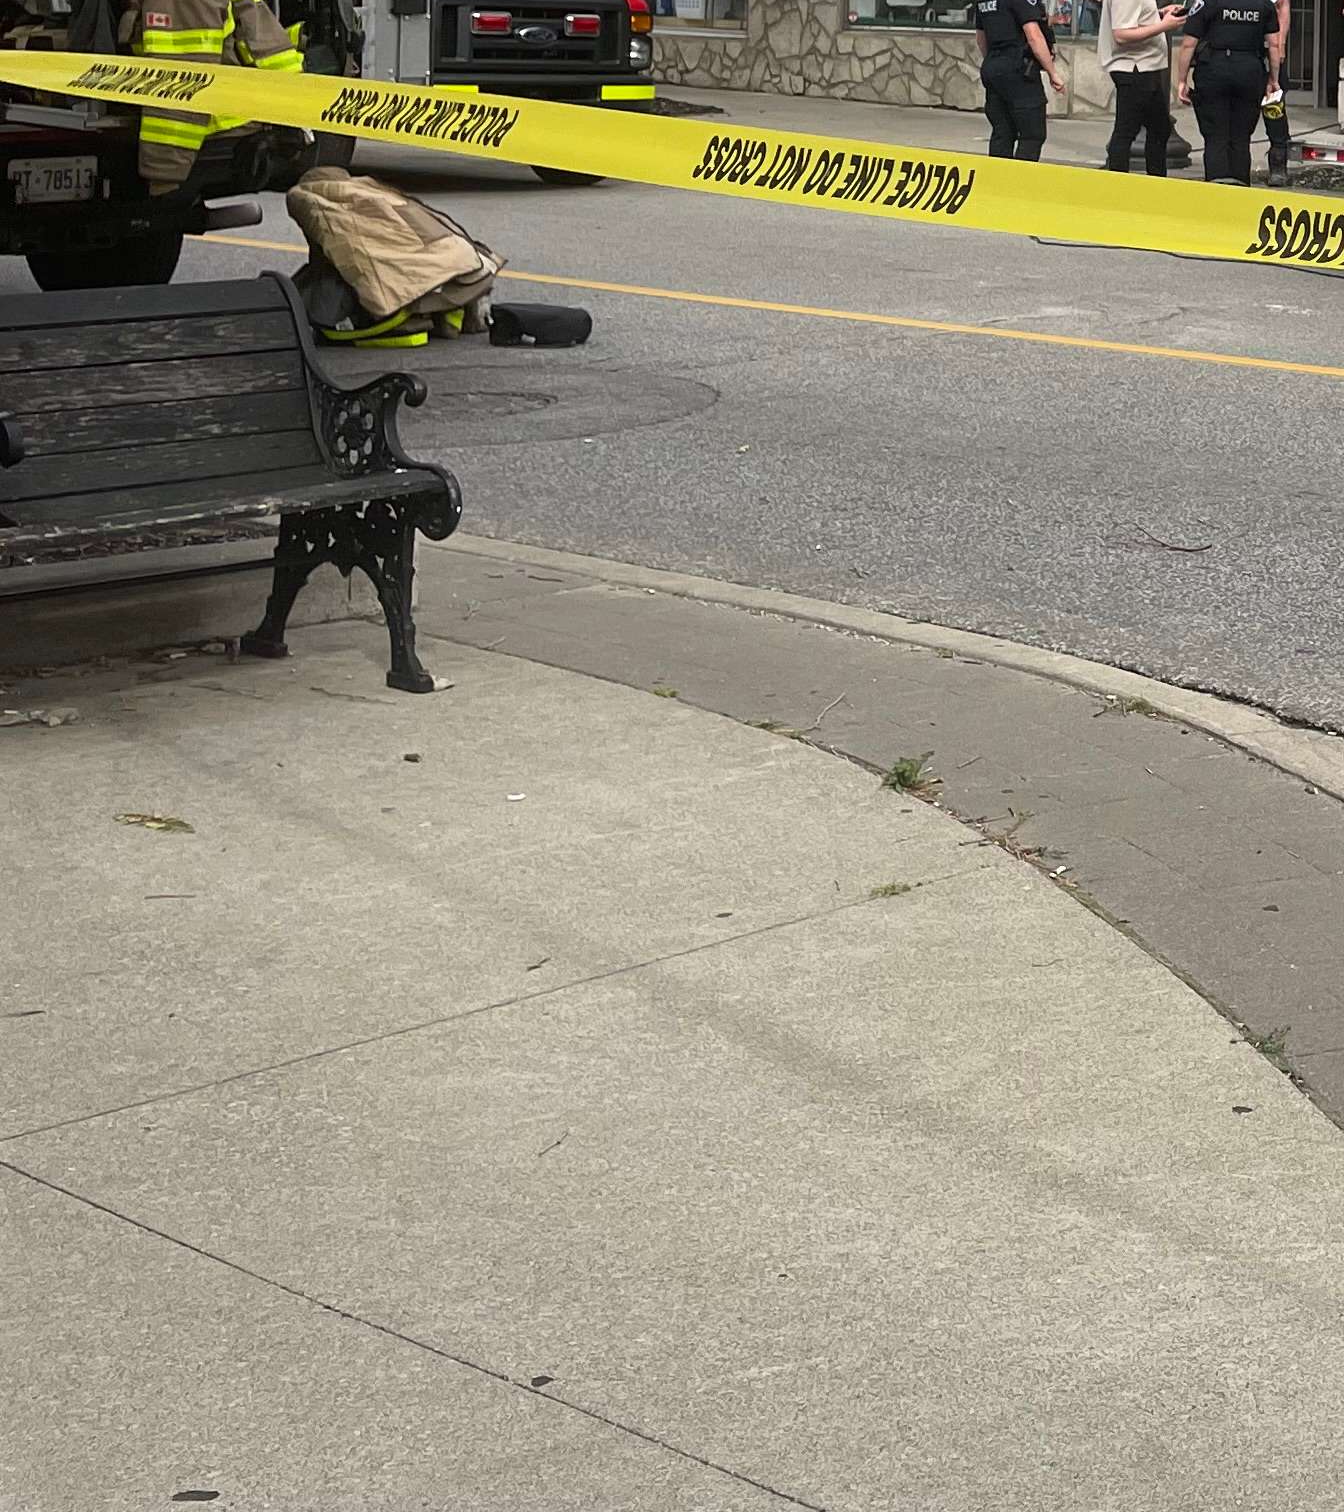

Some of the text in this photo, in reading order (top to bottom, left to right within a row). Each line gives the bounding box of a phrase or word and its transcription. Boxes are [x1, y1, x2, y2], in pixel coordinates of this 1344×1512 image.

[1222, 9, 1260, 22] POLICE
[450, 103, 520, 147] POLICE
[692, 135, 976, 215] POLICE LINE DO NOT CROSS
